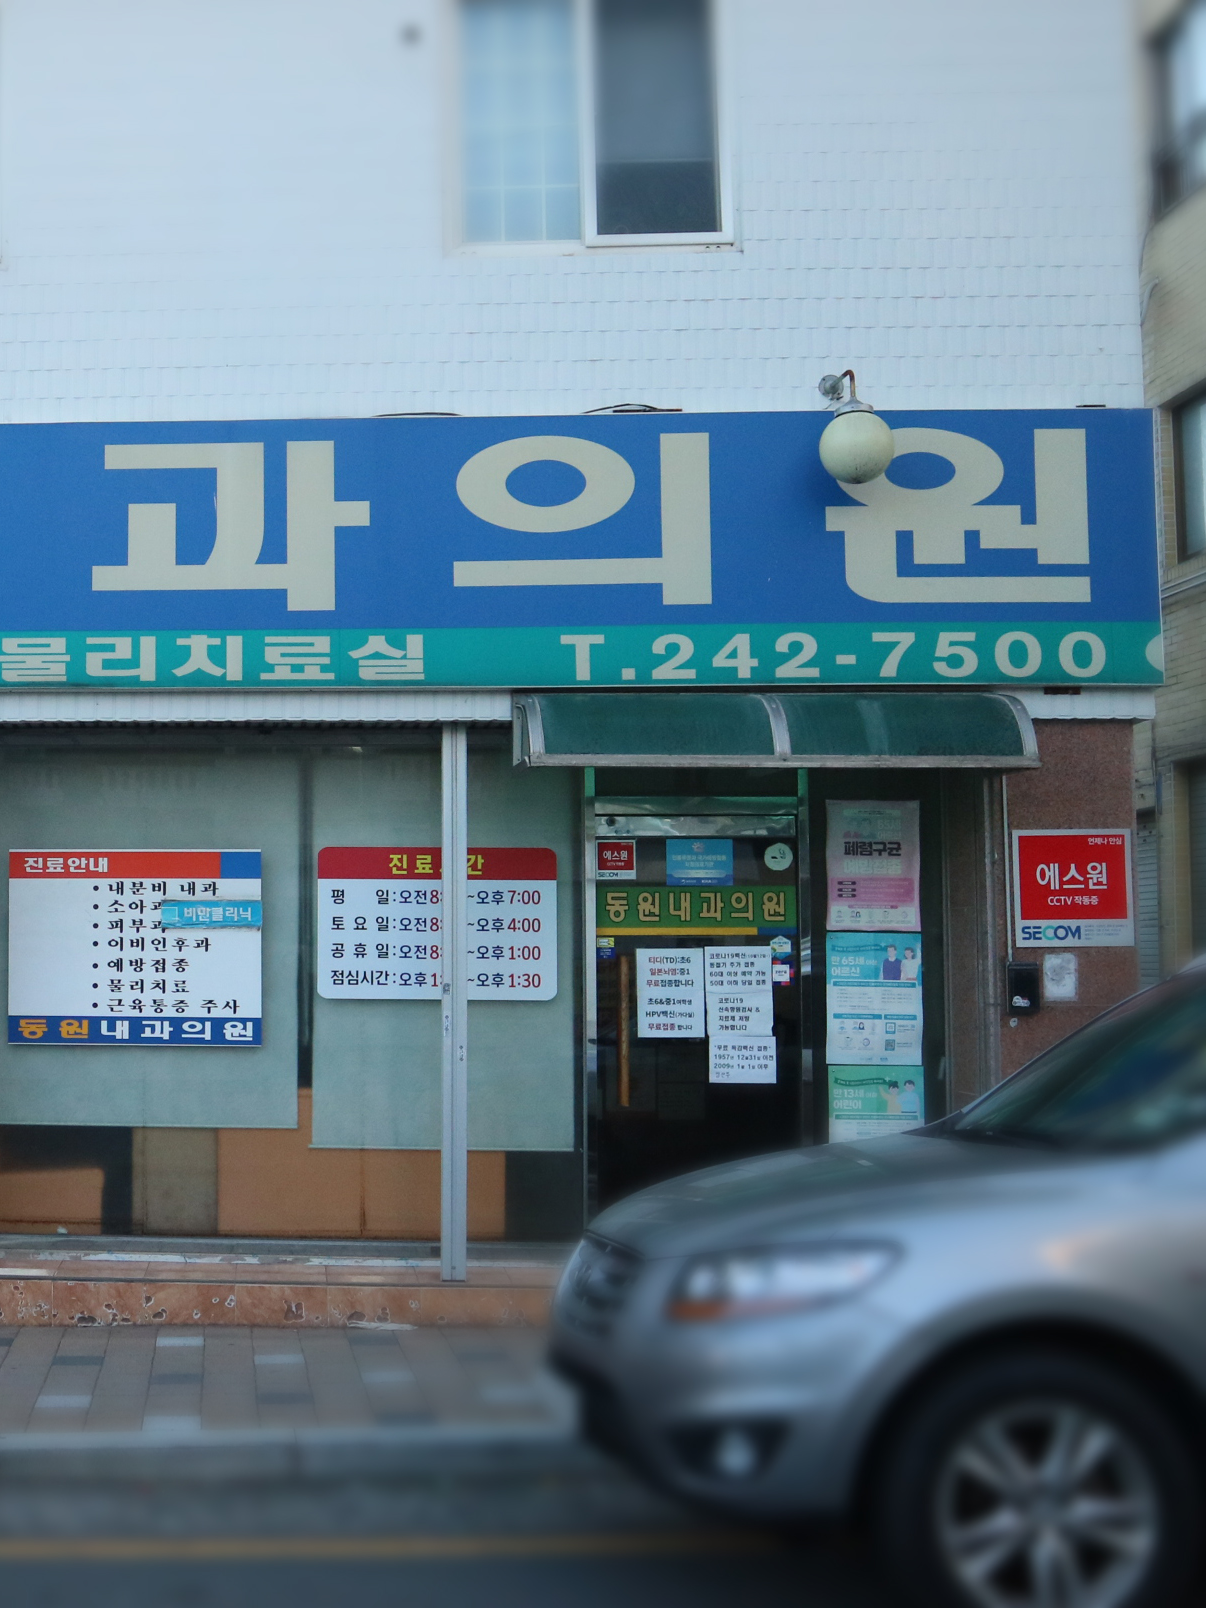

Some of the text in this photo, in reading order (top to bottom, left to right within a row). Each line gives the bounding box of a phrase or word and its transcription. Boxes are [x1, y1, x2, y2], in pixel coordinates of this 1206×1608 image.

[560, 631, 1107, 682] T.242-7500
[843, 841, 902, 857] 폐렴구균
[1087, 837, 1122, 845] 언제나 안심
[603, 850, 628, 861] 에스원
[24, 857, 109, 873] 진료안내
[389, 854, 485, 875] 진료간
[1035, 862, 1108, 890] 에스원
[107, 880, 219, 896] 내분비 내과
[1047, 895, 1099, 906] CCTV 작동중
[183, 906, 252, 922] 비만클리닉
[1021, 925, 1081, 941] SECOM
[107, 936, 212, 952] 이비인후과
[107, 958, 190, 973] 예방접종
[831, 966, 860, 977] 어르신
[107, 978, 190, 994] 물리치료
[107, 999, 240, 1014] 근육통증 주사
[833, 1100, 862, 1109] 어린이
